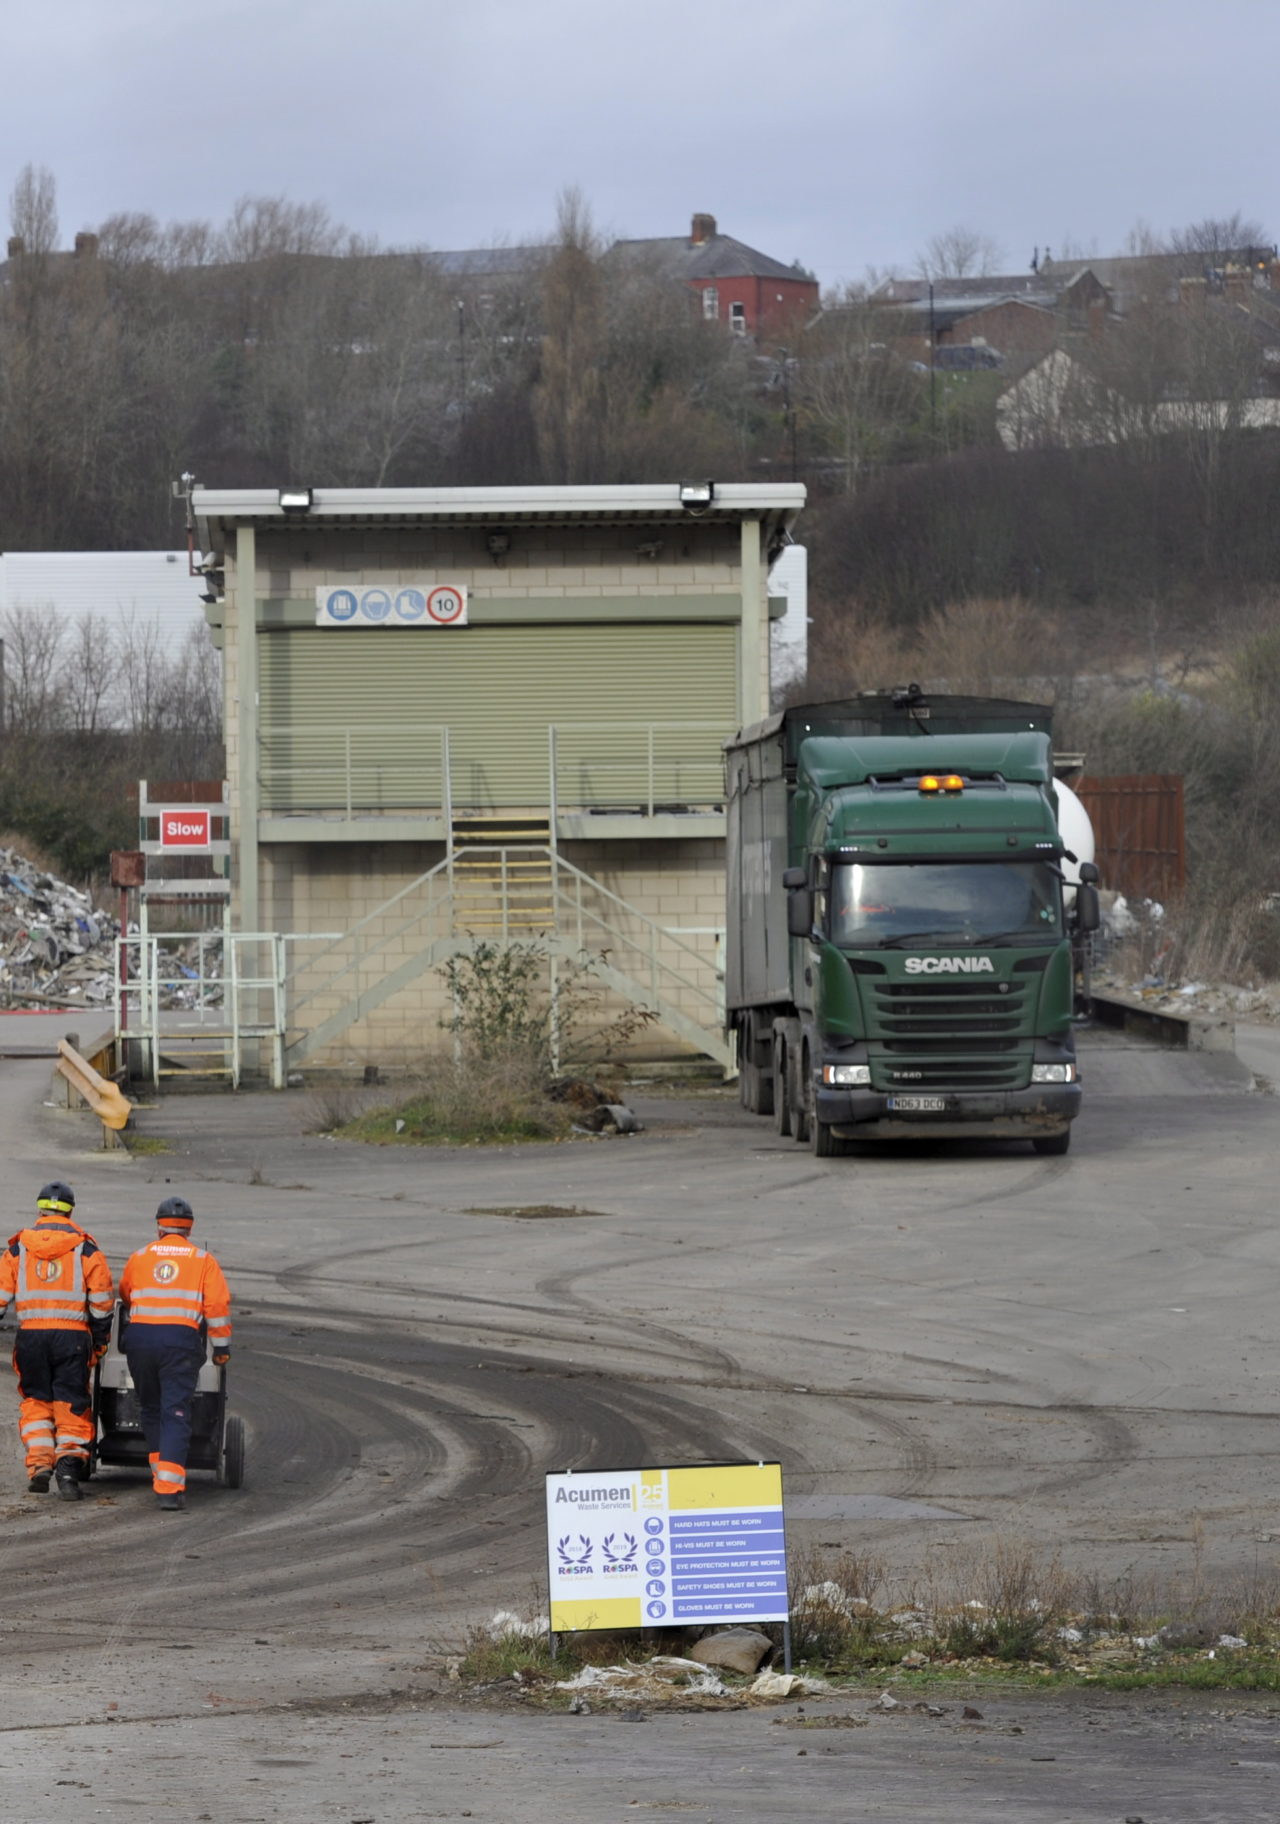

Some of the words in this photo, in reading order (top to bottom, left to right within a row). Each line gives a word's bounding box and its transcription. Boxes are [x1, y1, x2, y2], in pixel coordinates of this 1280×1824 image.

[437, 598, 454, 611] 10
[167, 821, 204, 836] Slow
[904, 956, 995, 974] SCANIA
[894, 1098, 920, 1109] ND63
[150, 1244, 192, 1253] Acumen
[555, 1487, 631, 1503] Acumen
[577, 1503, 599, 1511] Waste
[600, 1502, 631, 1510] Services
[690, 1562, 730, 1570] PROTECTION
[677, 1583, 702, 1591] SAFETY
